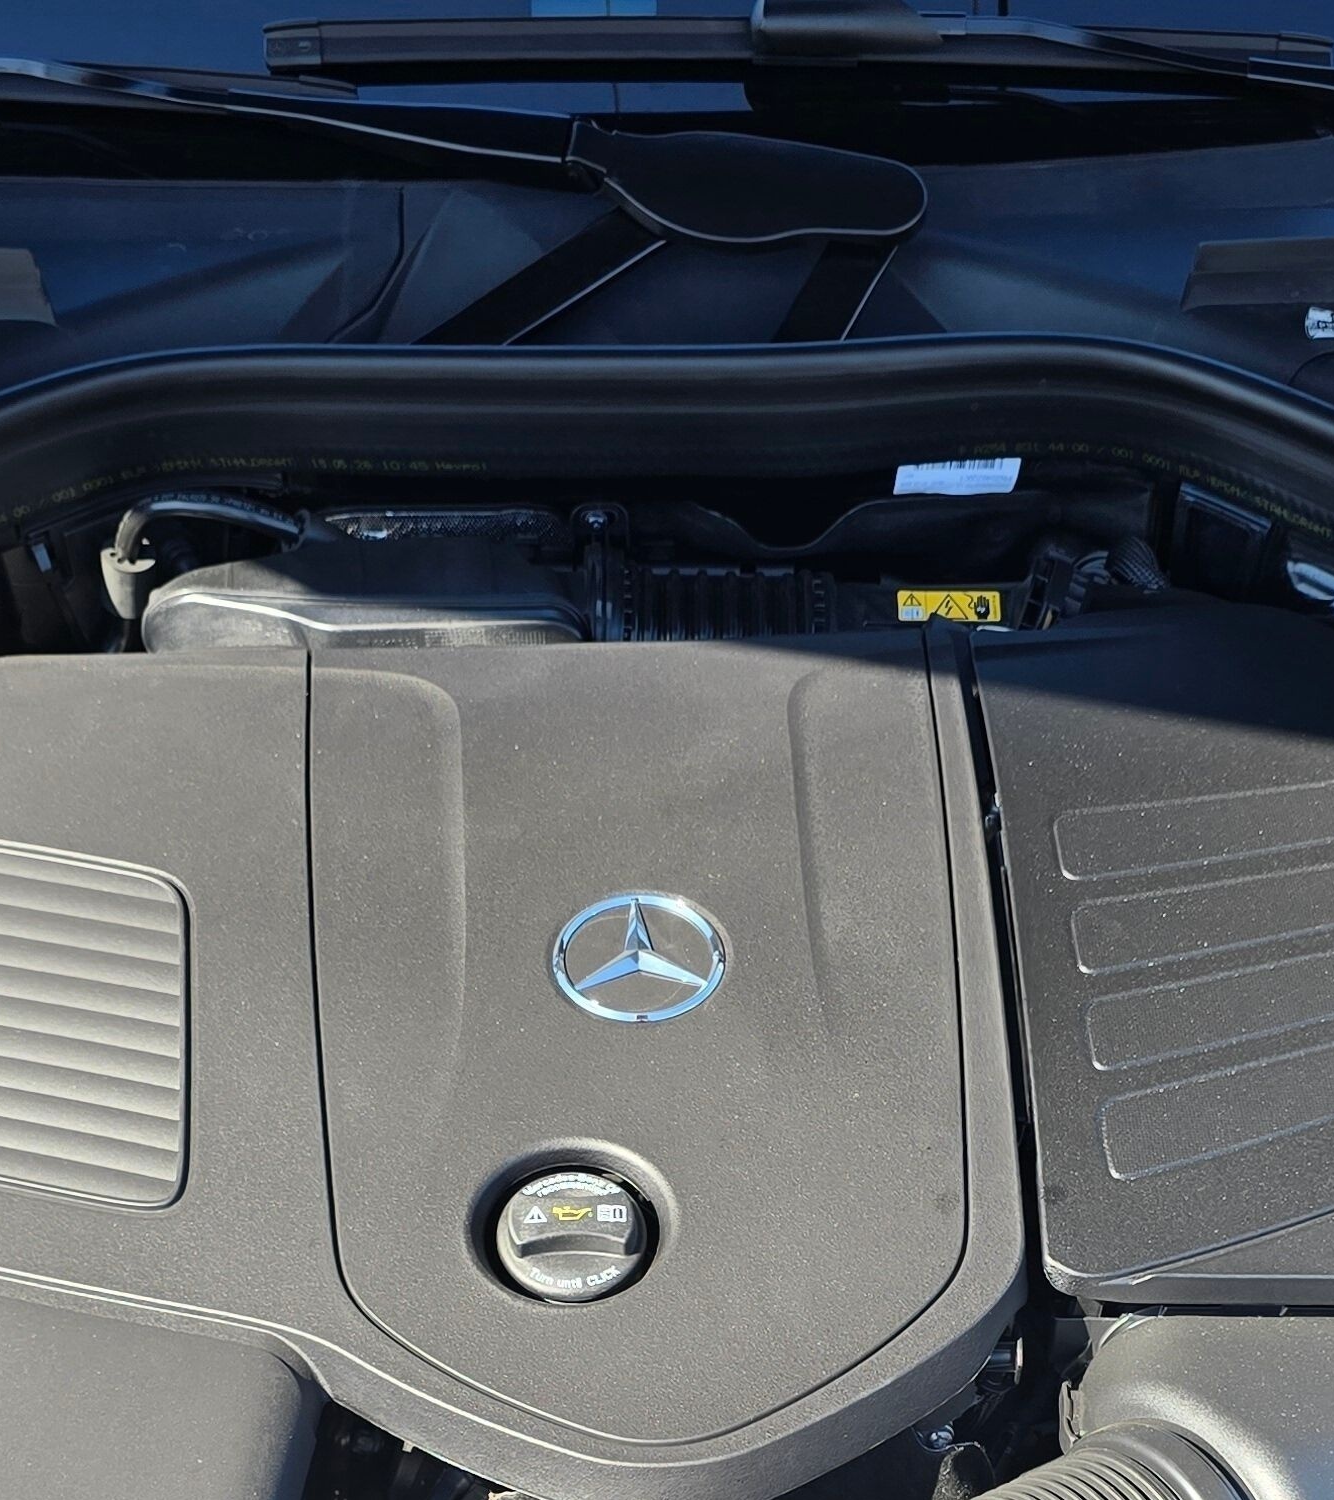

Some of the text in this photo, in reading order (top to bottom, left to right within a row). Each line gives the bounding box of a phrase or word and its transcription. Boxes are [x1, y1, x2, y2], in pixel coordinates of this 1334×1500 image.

[529, 1265, 621, 1289] Turn until CLICK
